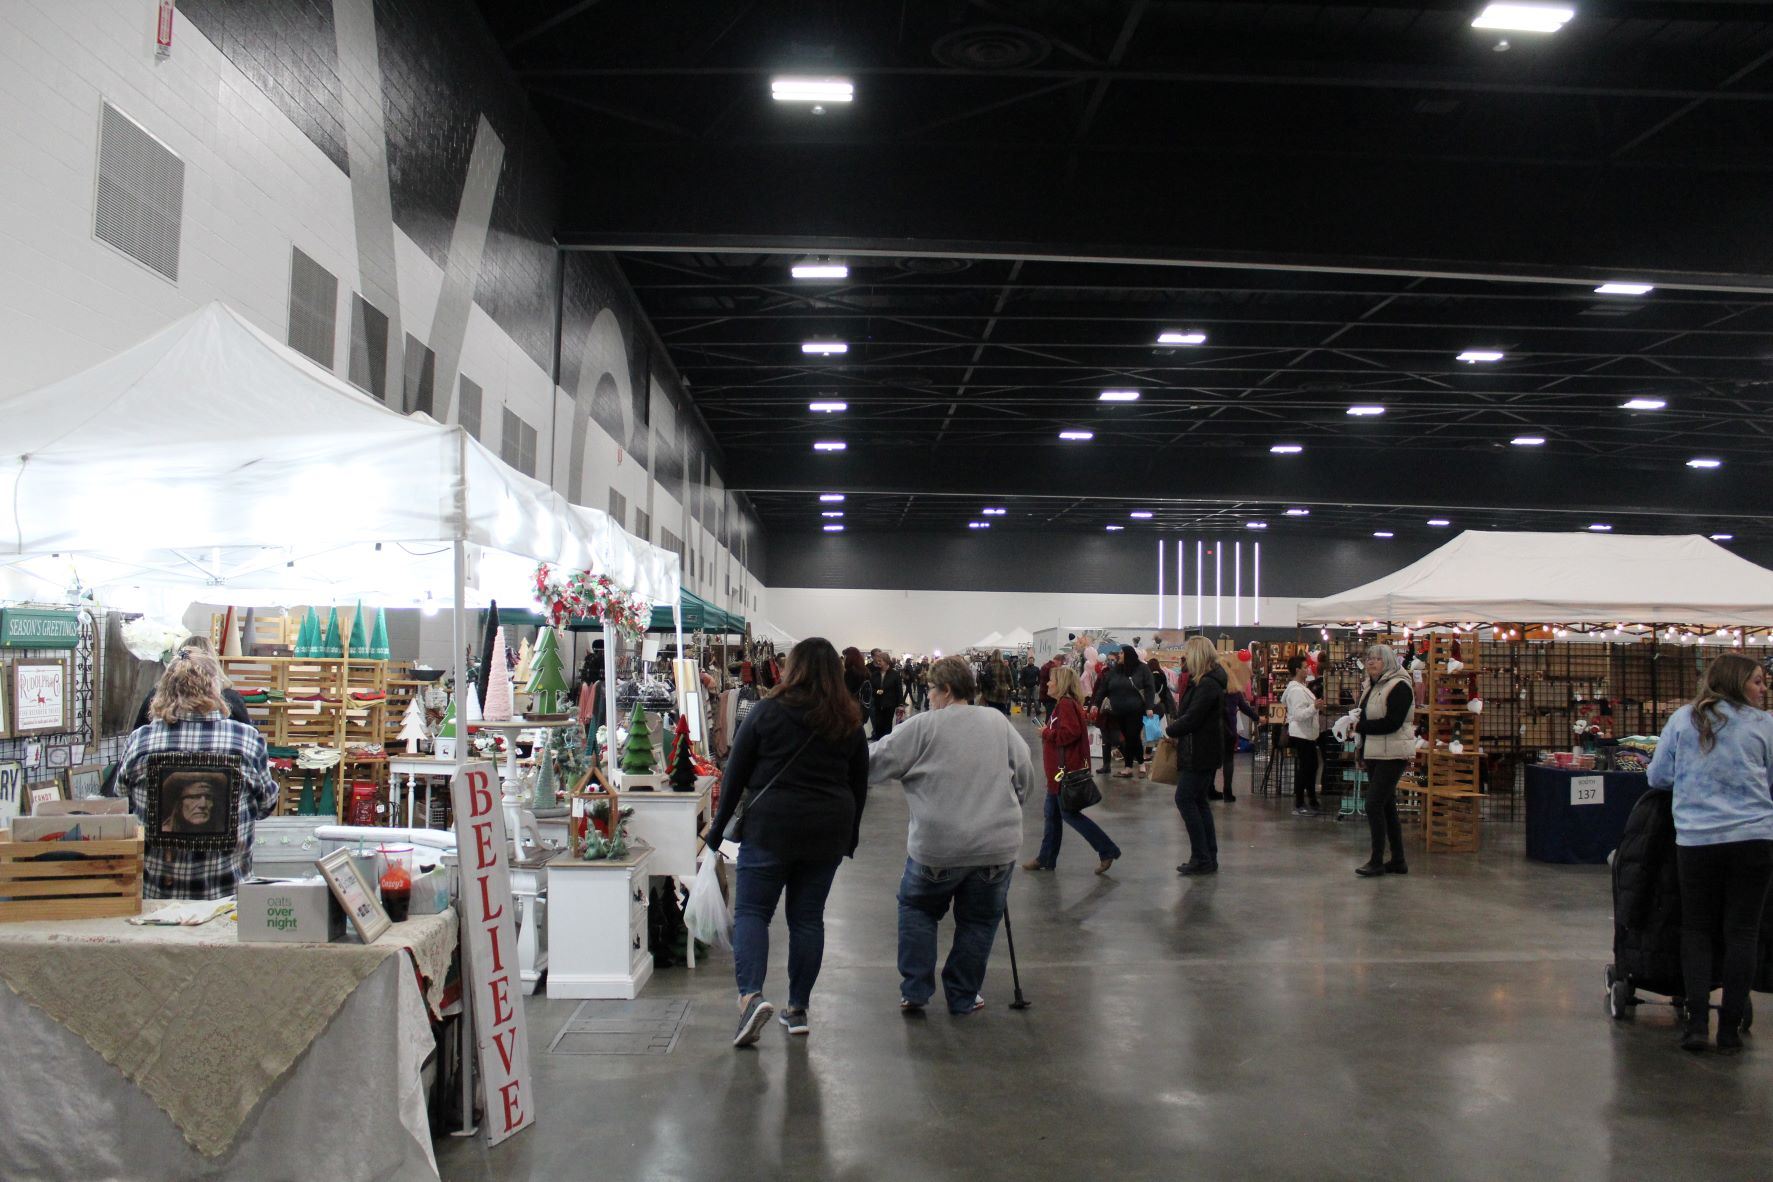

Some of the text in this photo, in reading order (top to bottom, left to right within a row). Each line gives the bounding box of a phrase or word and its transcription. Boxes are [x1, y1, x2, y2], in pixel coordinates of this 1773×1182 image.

[9, 620, 78, 637] SEASON'S GREETINGS
[1578, 790, 1596, 800] 137
[267, 897, 292, 907] oats
[267, 907, 294, 917] over
[267, 917, 297, 930] night
[465, 771, 523, 1133] BELIEVE
